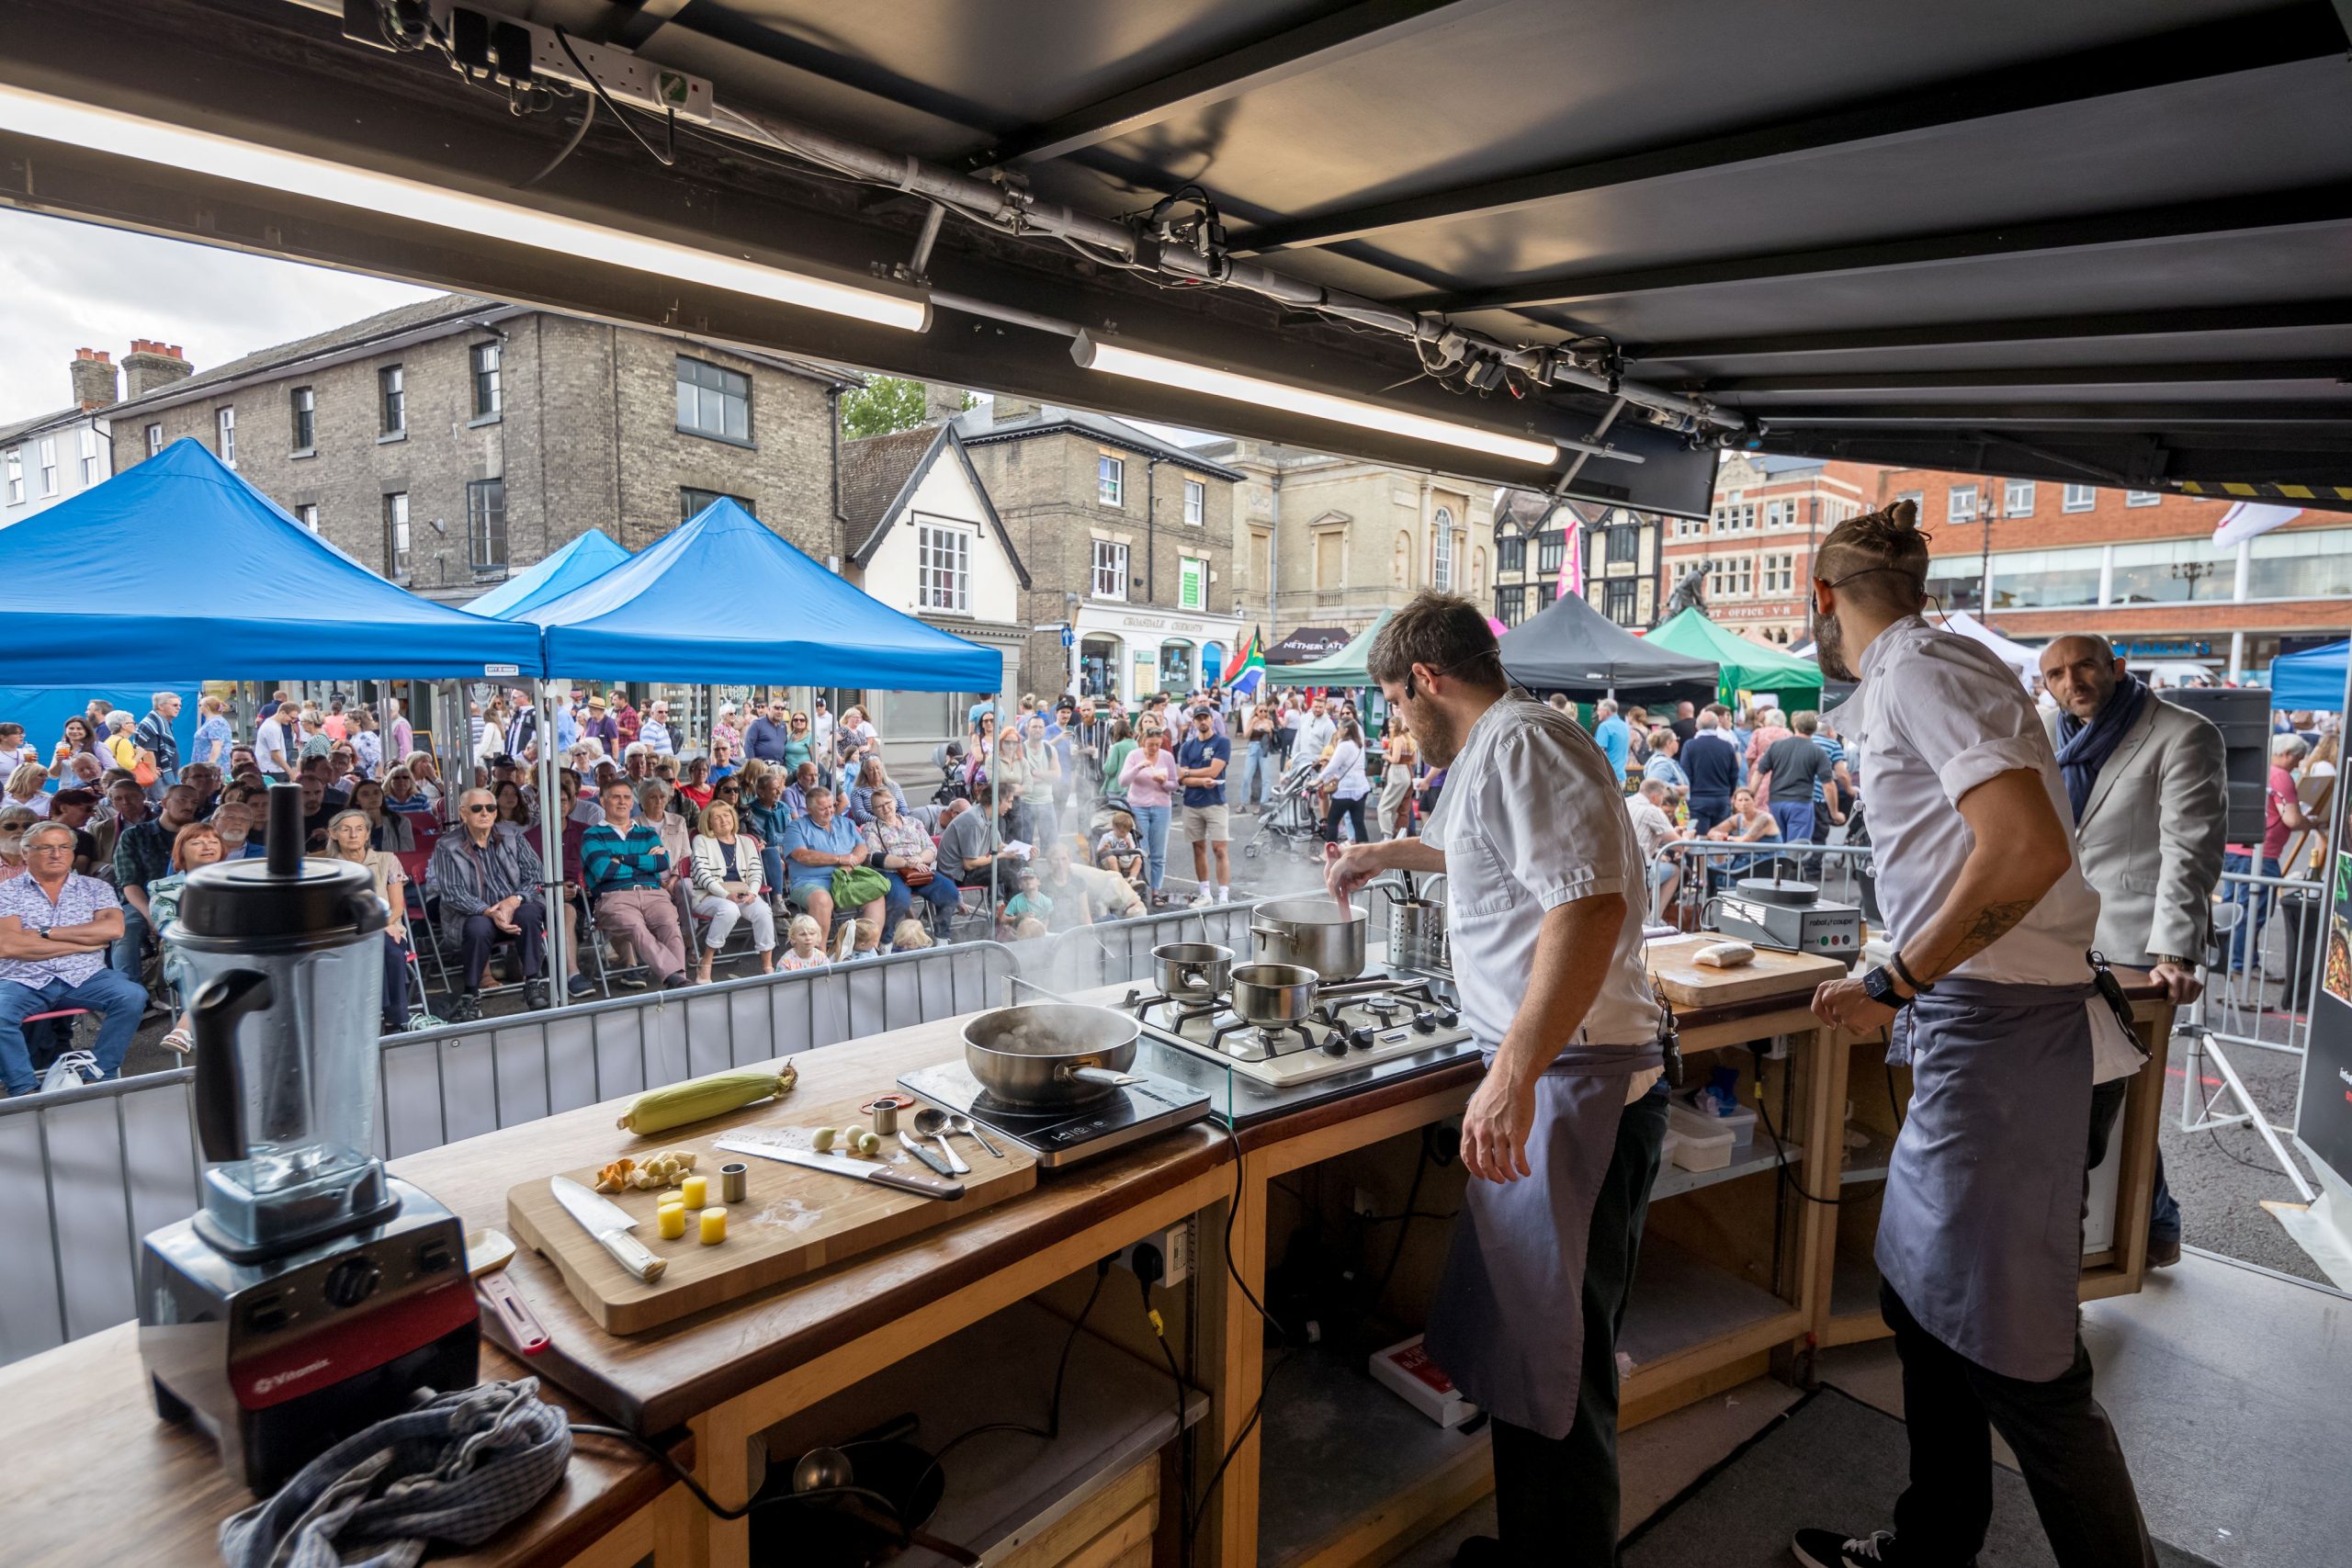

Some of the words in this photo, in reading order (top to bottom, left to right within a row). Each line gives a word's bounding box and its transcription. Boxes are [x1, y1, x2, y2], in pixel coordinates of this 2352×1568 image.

[1728, 607, 1764, 616] OFFICE
[1124, 617, 1165, 627] CROASDALE
[1171, 622, 1204, 632] CHEMISTS
[275, 1359, 331, 1385] Vitamix
